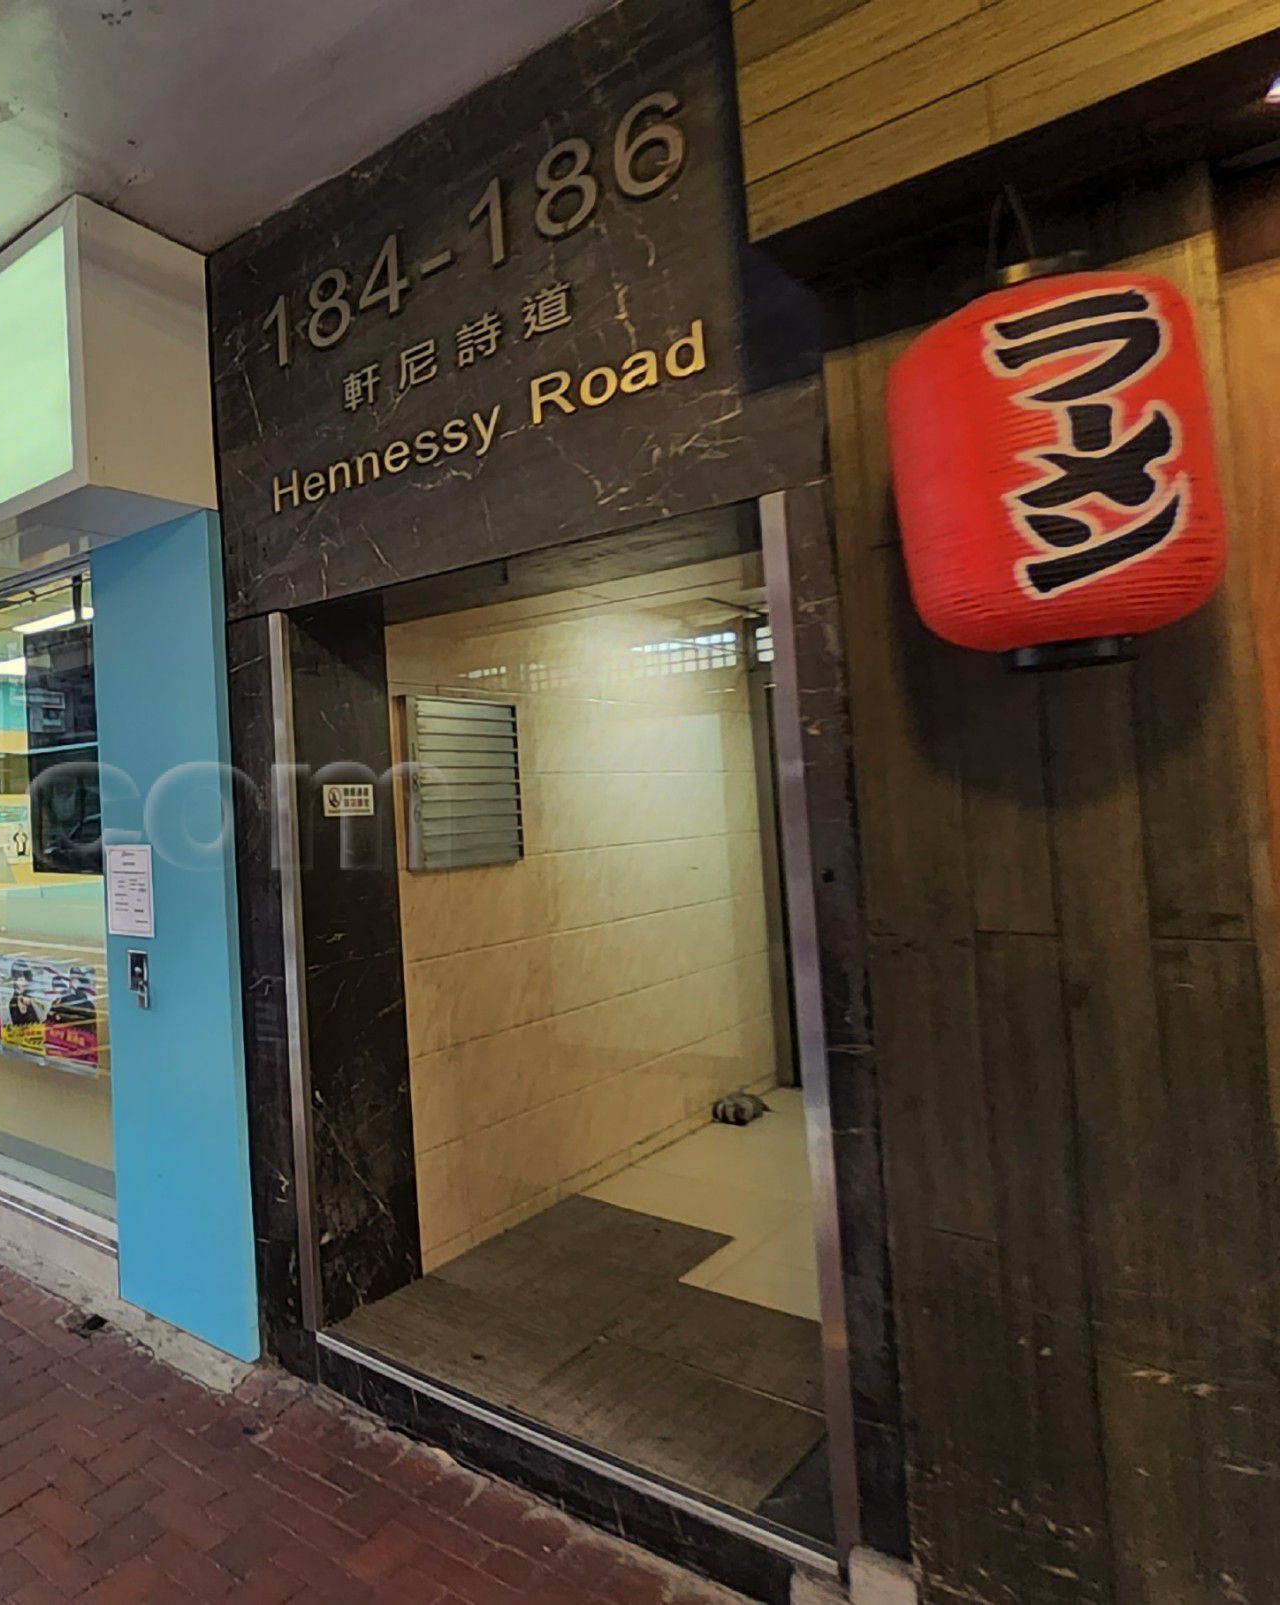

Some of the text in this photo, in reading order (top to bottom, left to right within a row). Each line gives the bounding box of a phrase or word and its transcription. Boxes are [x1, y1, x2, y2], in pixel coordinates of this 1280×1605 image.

[262, 90, 687, 367] 184-186
[271, 319, 707, 513] Hennessy Road
[342, 282, 573, 412] 軒尼詩道
[988, 288, 1189, 596] ラーメン
